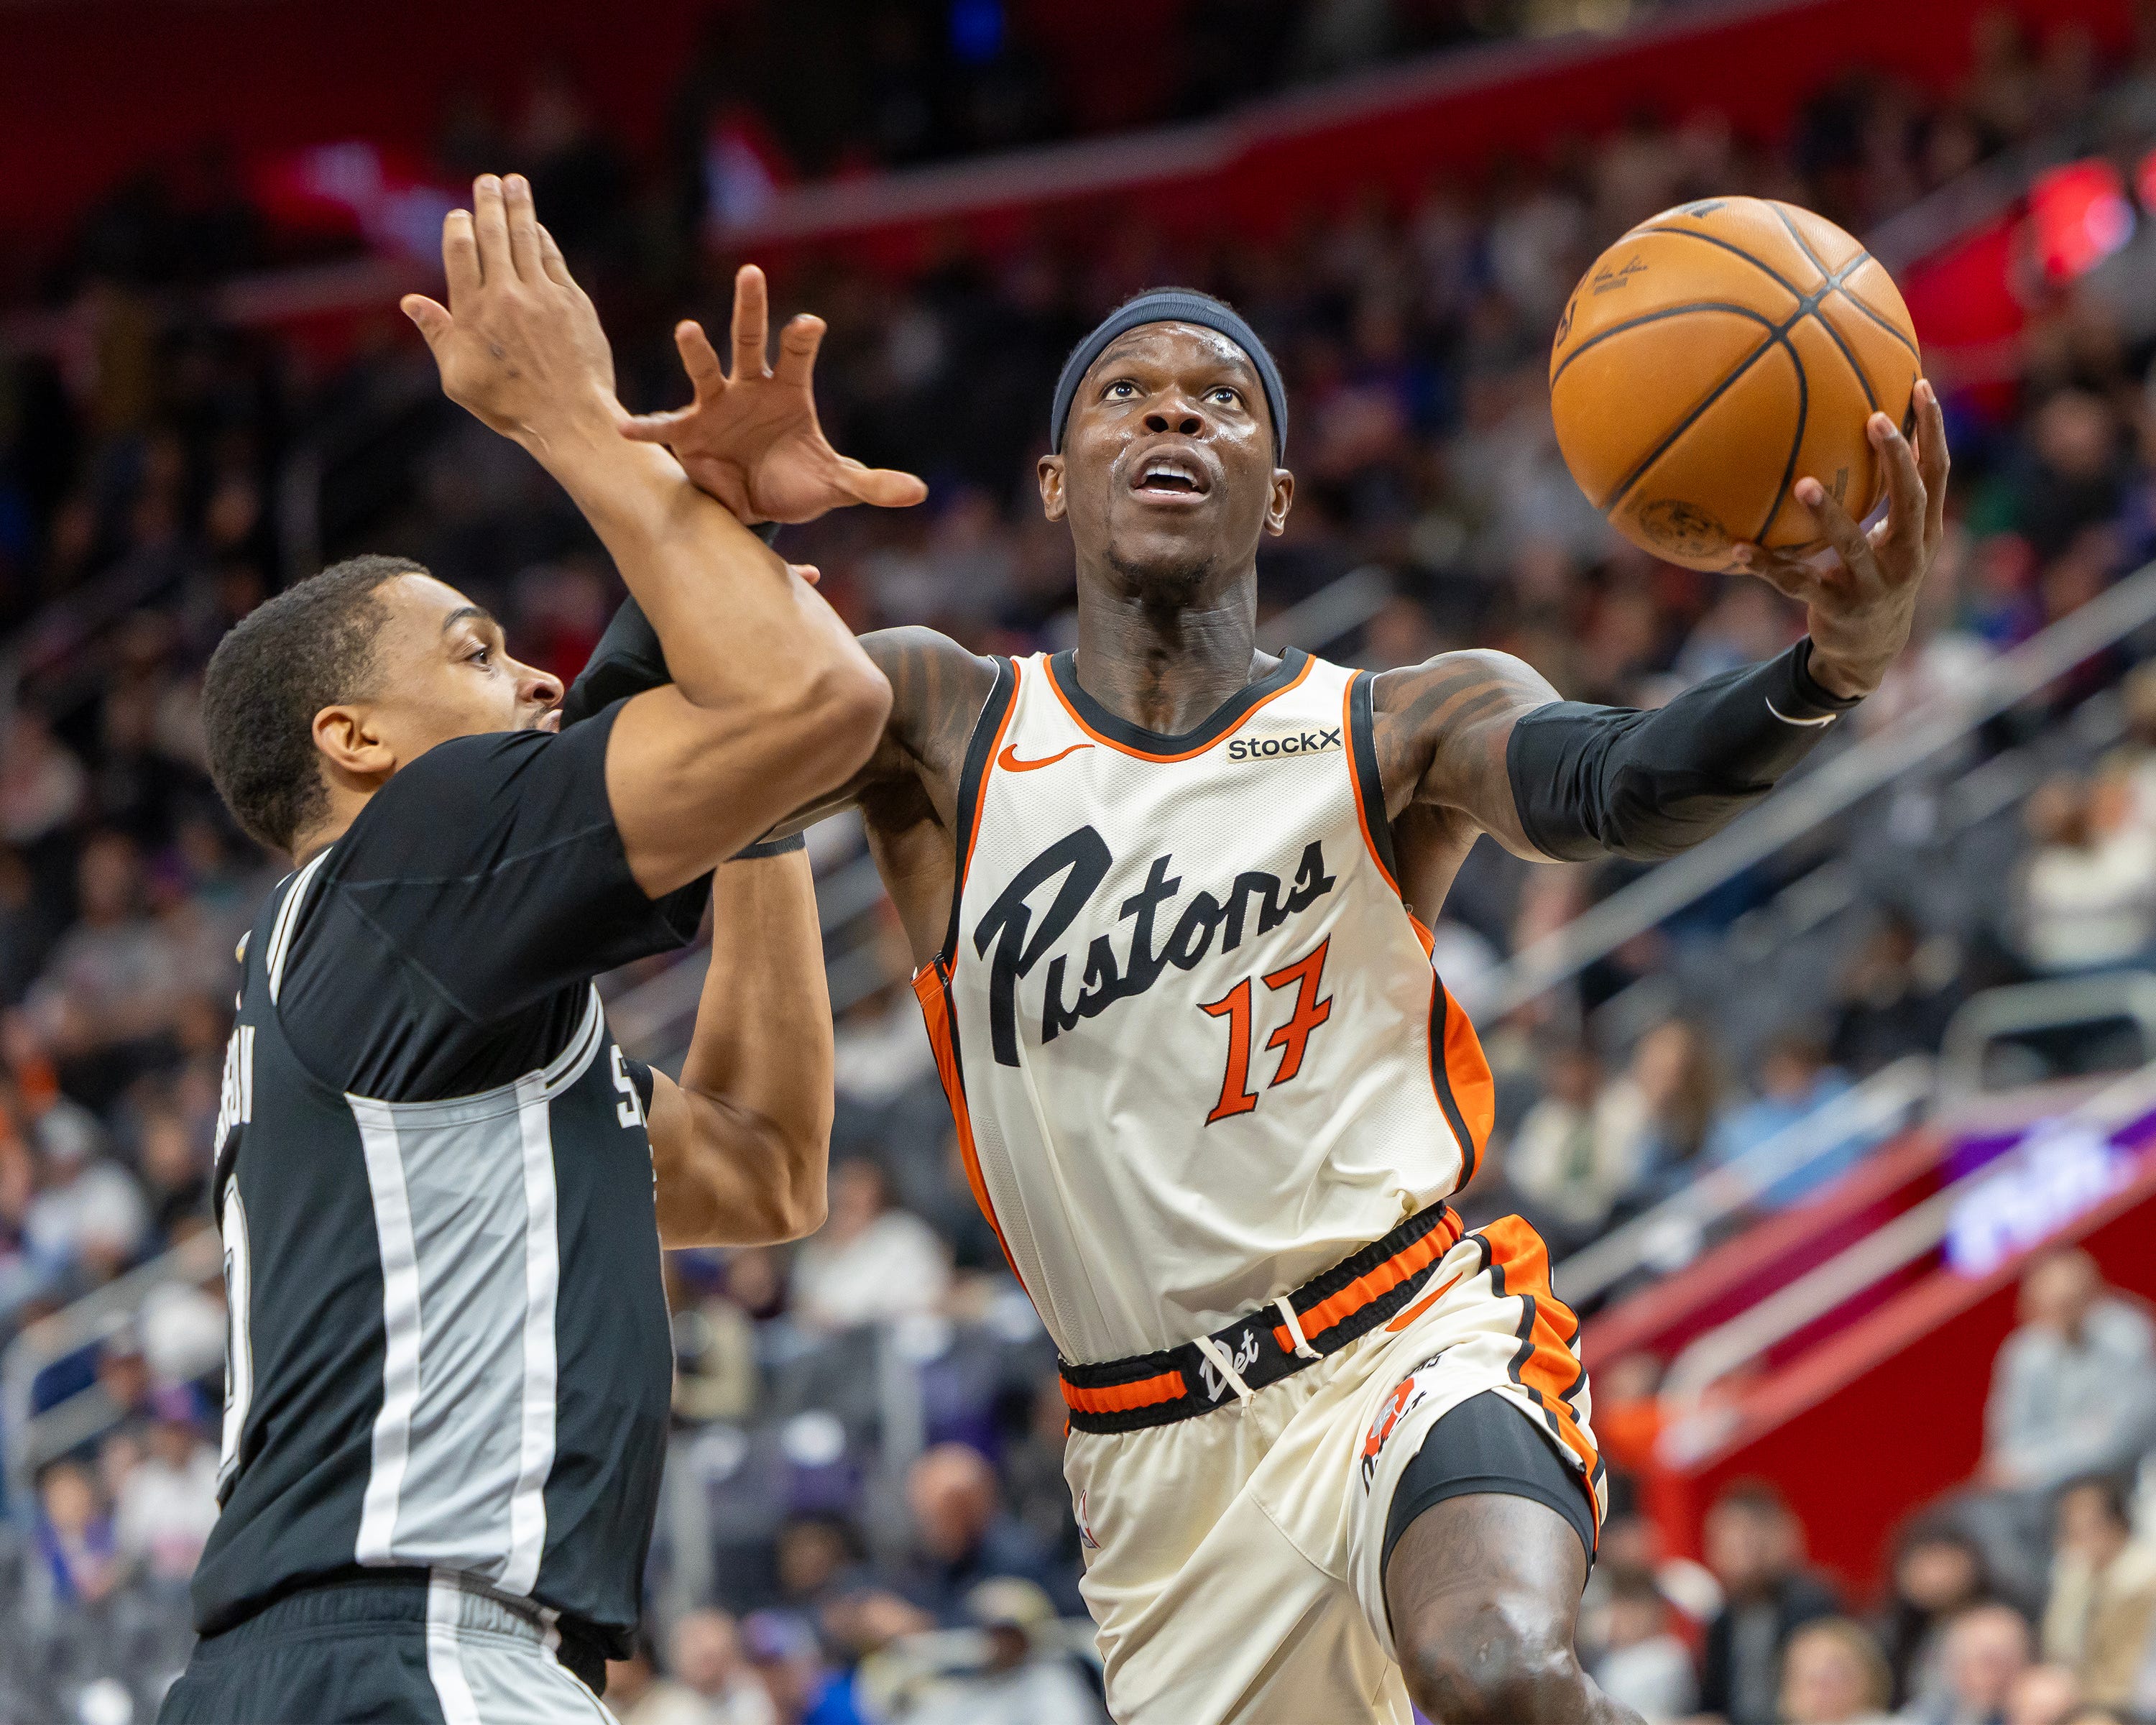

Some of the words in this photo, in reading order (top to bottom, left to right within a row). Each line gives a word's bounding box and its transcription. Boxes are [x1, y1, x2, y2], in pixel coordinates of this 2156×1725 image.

[1229, 727, 1341, 760] StockX
[973, 824, 1337, 1068] Pistons
[1196, 932, 1334, 1128] 17
[1199, 1328, 1259, 1402] Det
